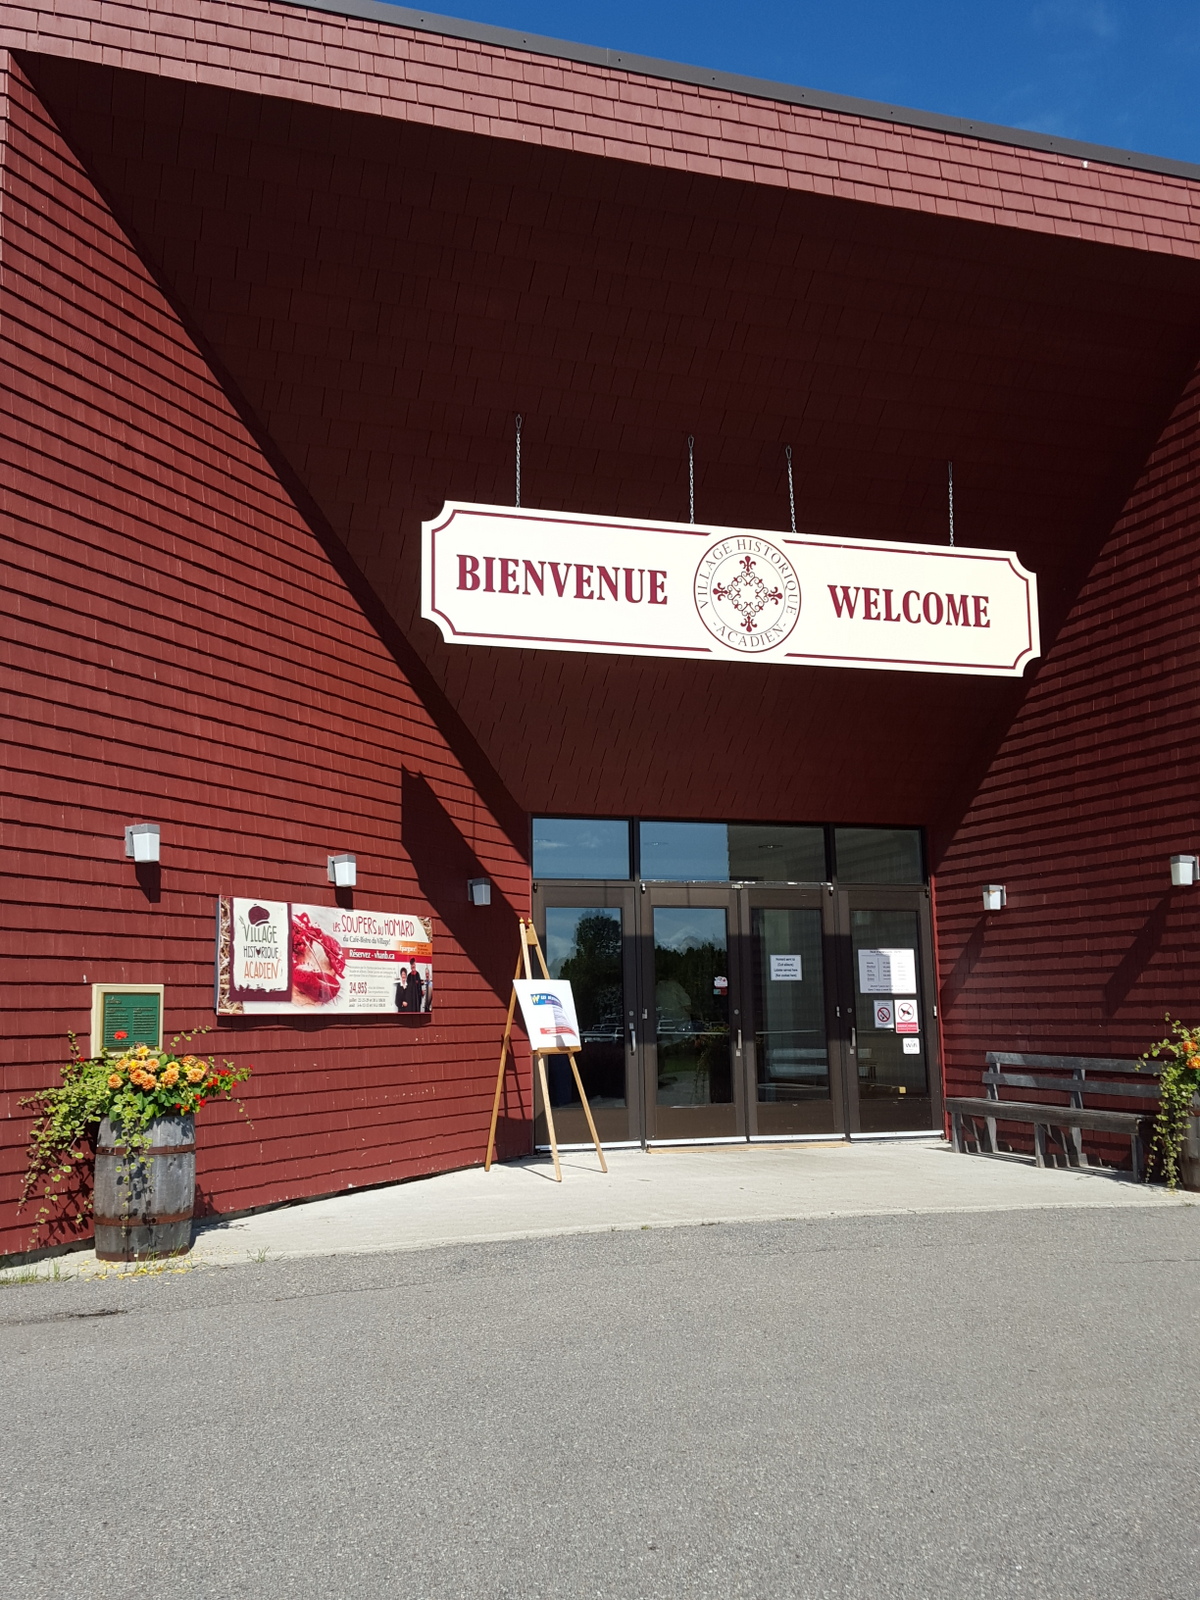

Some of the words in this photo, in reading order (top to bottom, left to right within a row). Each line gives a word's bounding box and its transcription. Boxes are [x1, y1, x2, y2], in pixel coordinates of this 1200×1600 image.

[455, 553, 668, 605] BIENVENUE
[697, 542, 733, 609] VILLAGE
[736, 538, 798, 616] HISTORIQUE
[826, 584, 991, 628] WELCOME
[242, 922, 278, 944] VILLAGE
[341, 914, 377, 935] SOUPERS
[384, 917, 415, 938] HOMARD
[243, 959, 281, 980] ACADIEN
